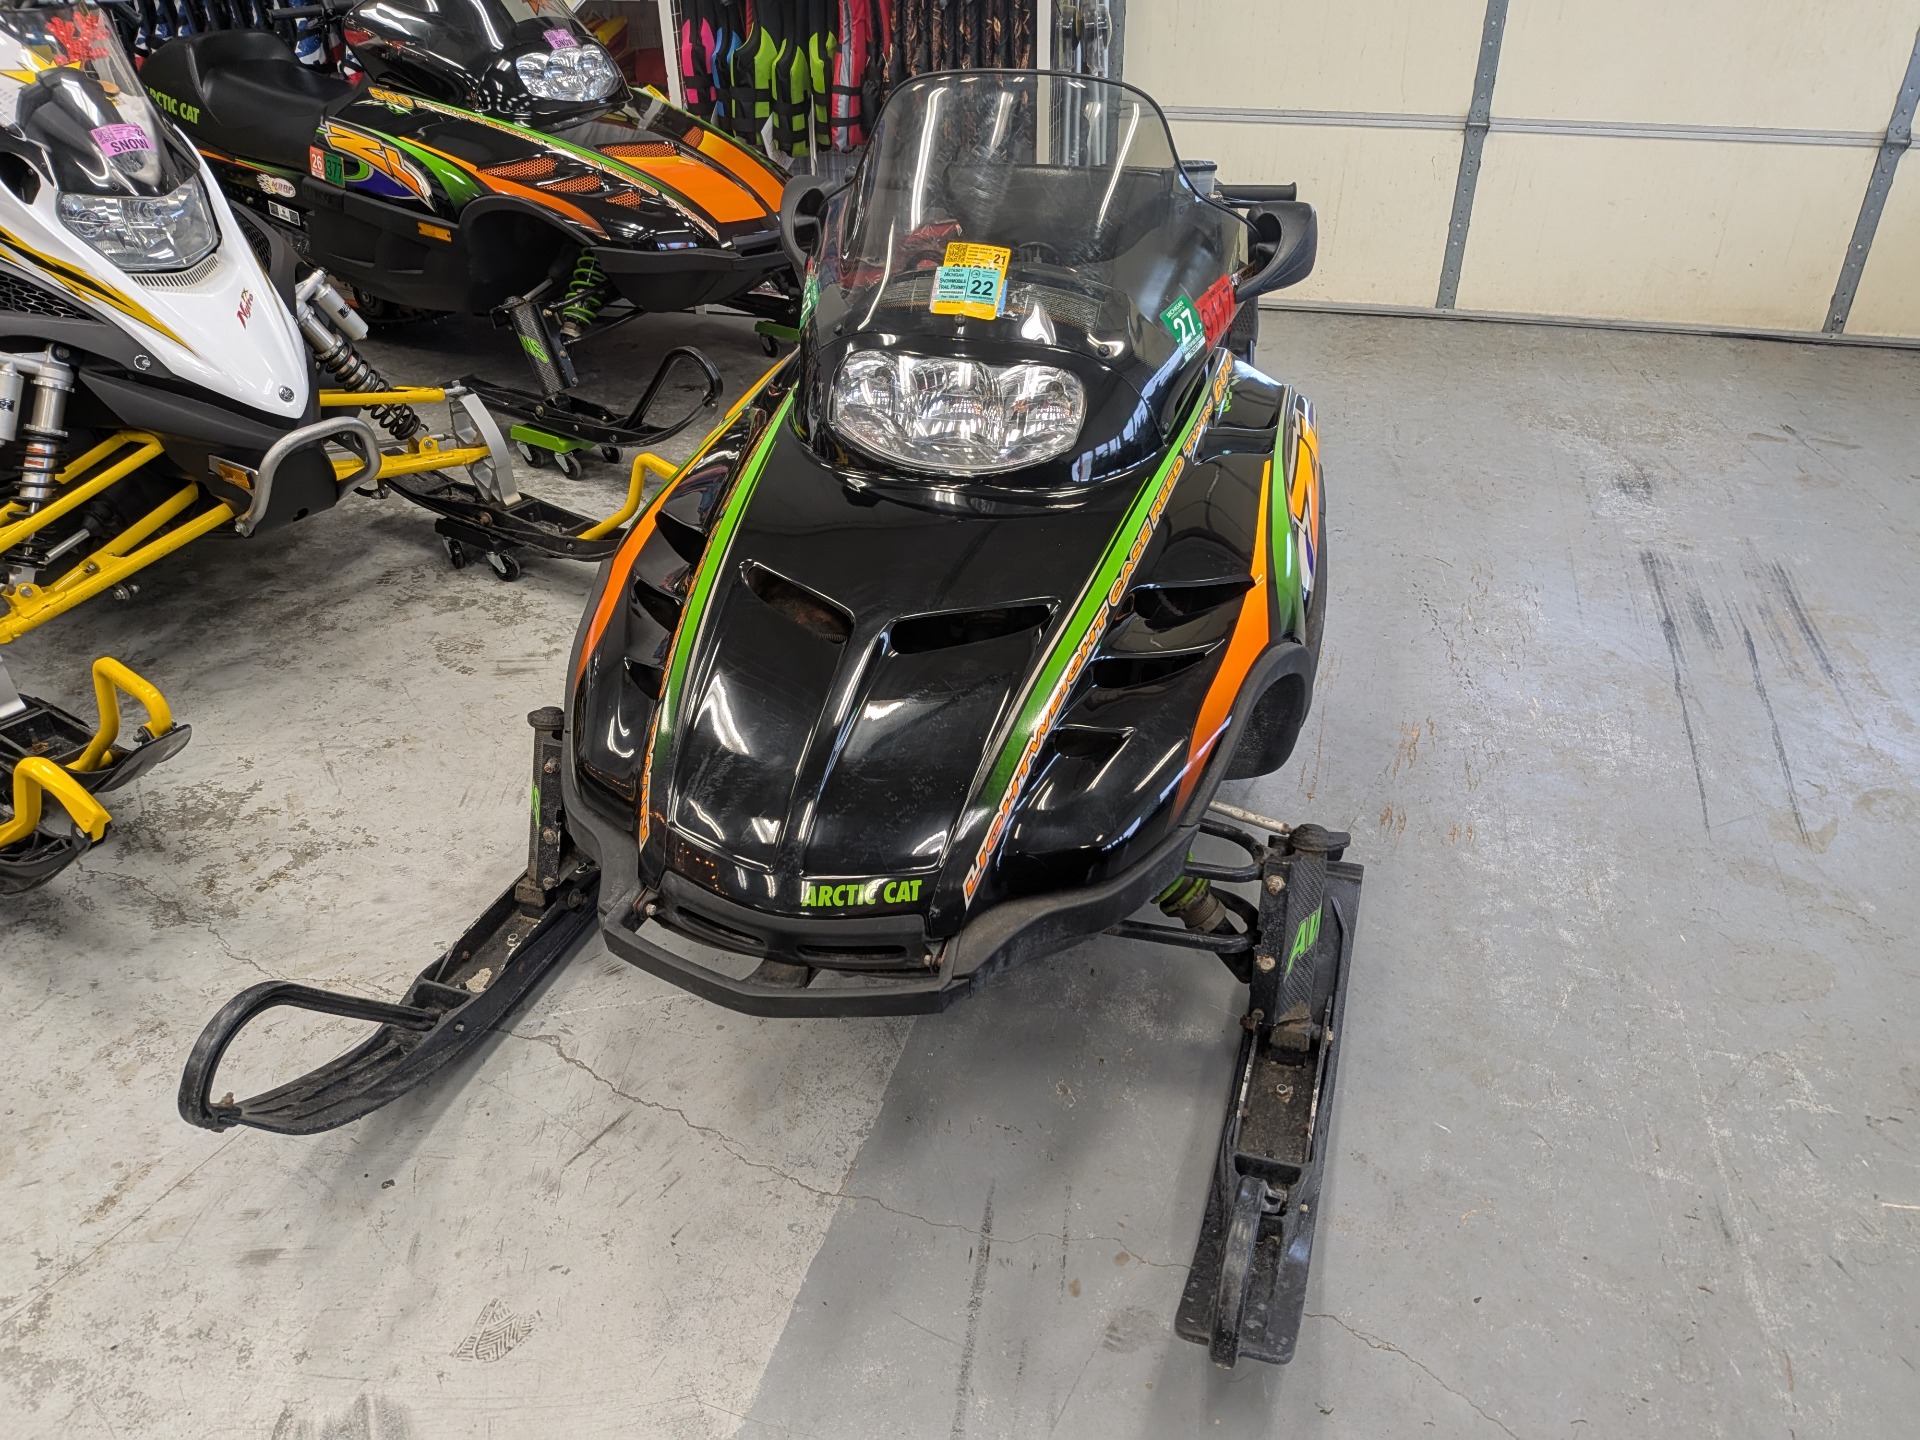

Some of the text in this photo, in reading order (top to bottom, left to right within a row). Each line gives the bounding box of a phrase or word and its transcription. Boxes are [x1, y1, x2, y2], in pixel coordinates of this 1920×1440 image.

[145, 85, 200, 124] RCTIC CAT
[368, 86, 415, 108] 500
[110, 138, 149, 153] SNOW
[311, 153, 323, 170] 26
[993, 253, 1007, 265] 21
[969, 279, 994, 297] 22
[1165, 300, 1184, 319] MICHIGAN
[1201, 284, 1231, 342] 9117
[1173, 307, 1197, 346] 27
[962, 351, 1234, 911] LIGHTWEIGHT CASE REED TWIN 600
[801, 879, 923, 907] ARCTIC CAT
